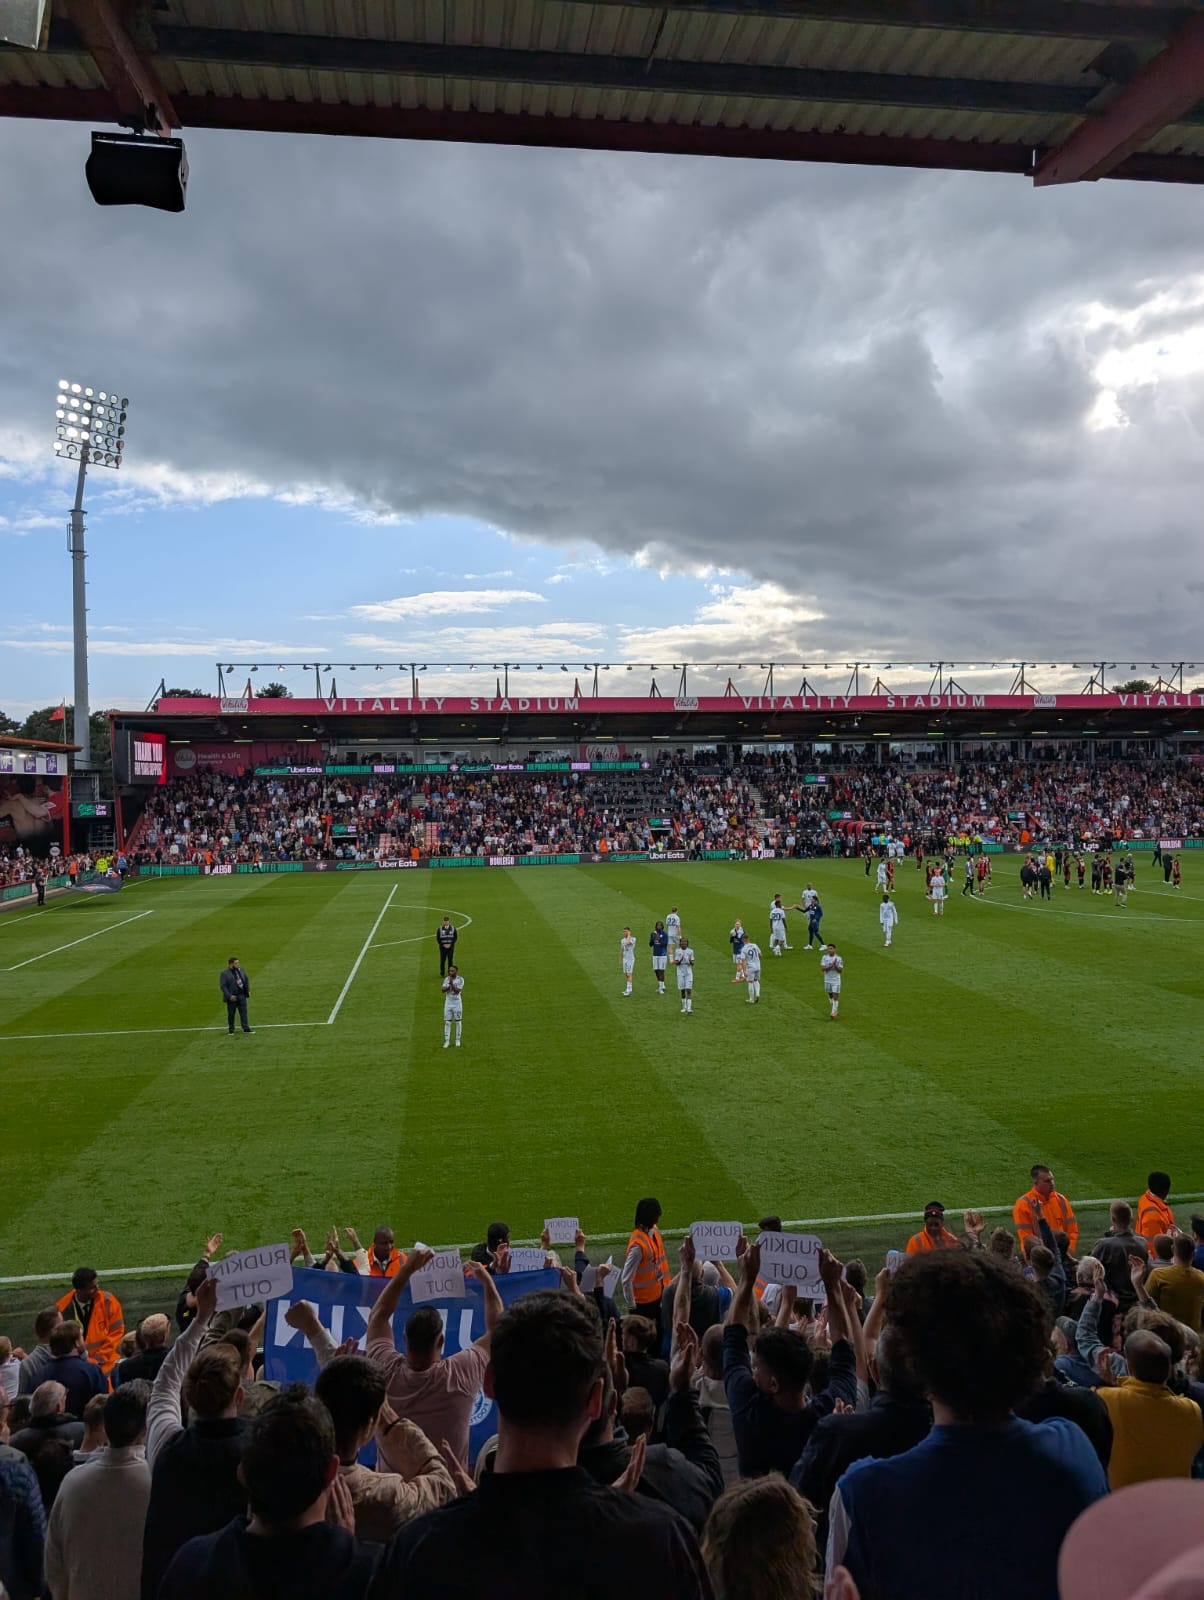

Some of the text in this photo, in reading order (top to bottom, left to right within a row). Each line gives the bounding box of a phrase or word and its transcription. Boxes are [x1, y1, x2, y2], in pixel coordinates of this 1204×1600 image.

[324, 697, 580, 711] VITALITY STADIUM
[742, 695, 986, 709] VITALITY STADIUM
[227, 752, 241, 760] Life
[650, 851, 666, 860] Uber
[667, 851, 685, 859] Eats
[379, 861, 397, 869] Uber
[398, 860, 417, 868] Eats
[748, 948, 758, 960] 91
